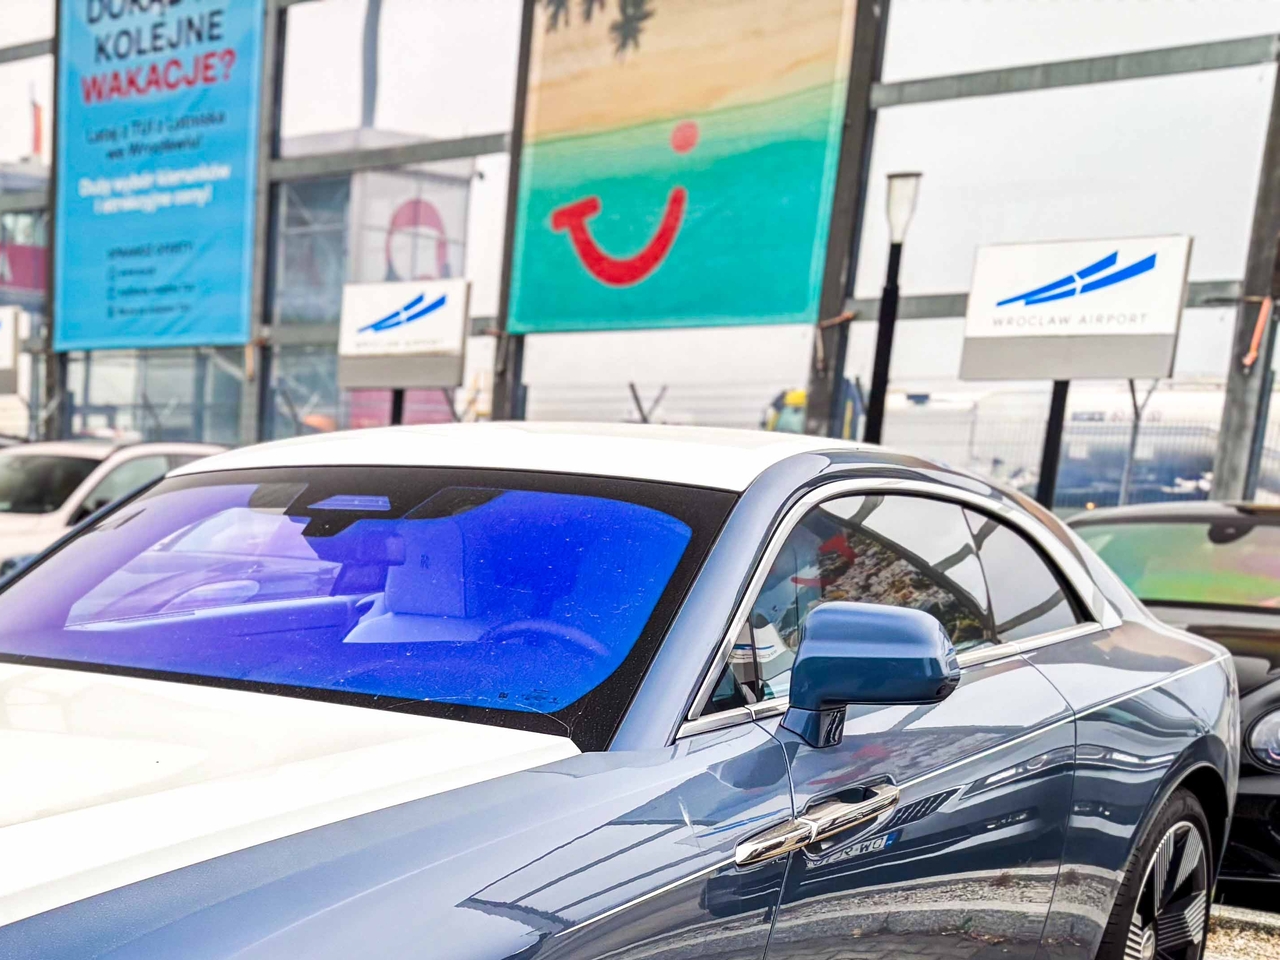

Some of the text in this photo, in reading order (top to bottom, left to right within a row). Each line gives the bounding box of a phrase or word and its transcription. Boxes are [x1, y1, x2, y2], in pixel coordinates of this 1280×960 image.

[94, 9, 225, 64] KOLEJNE
[81, 48, 237, 104] WAKACJE?
[1079, 313, 1149, 325] AIRPORT
